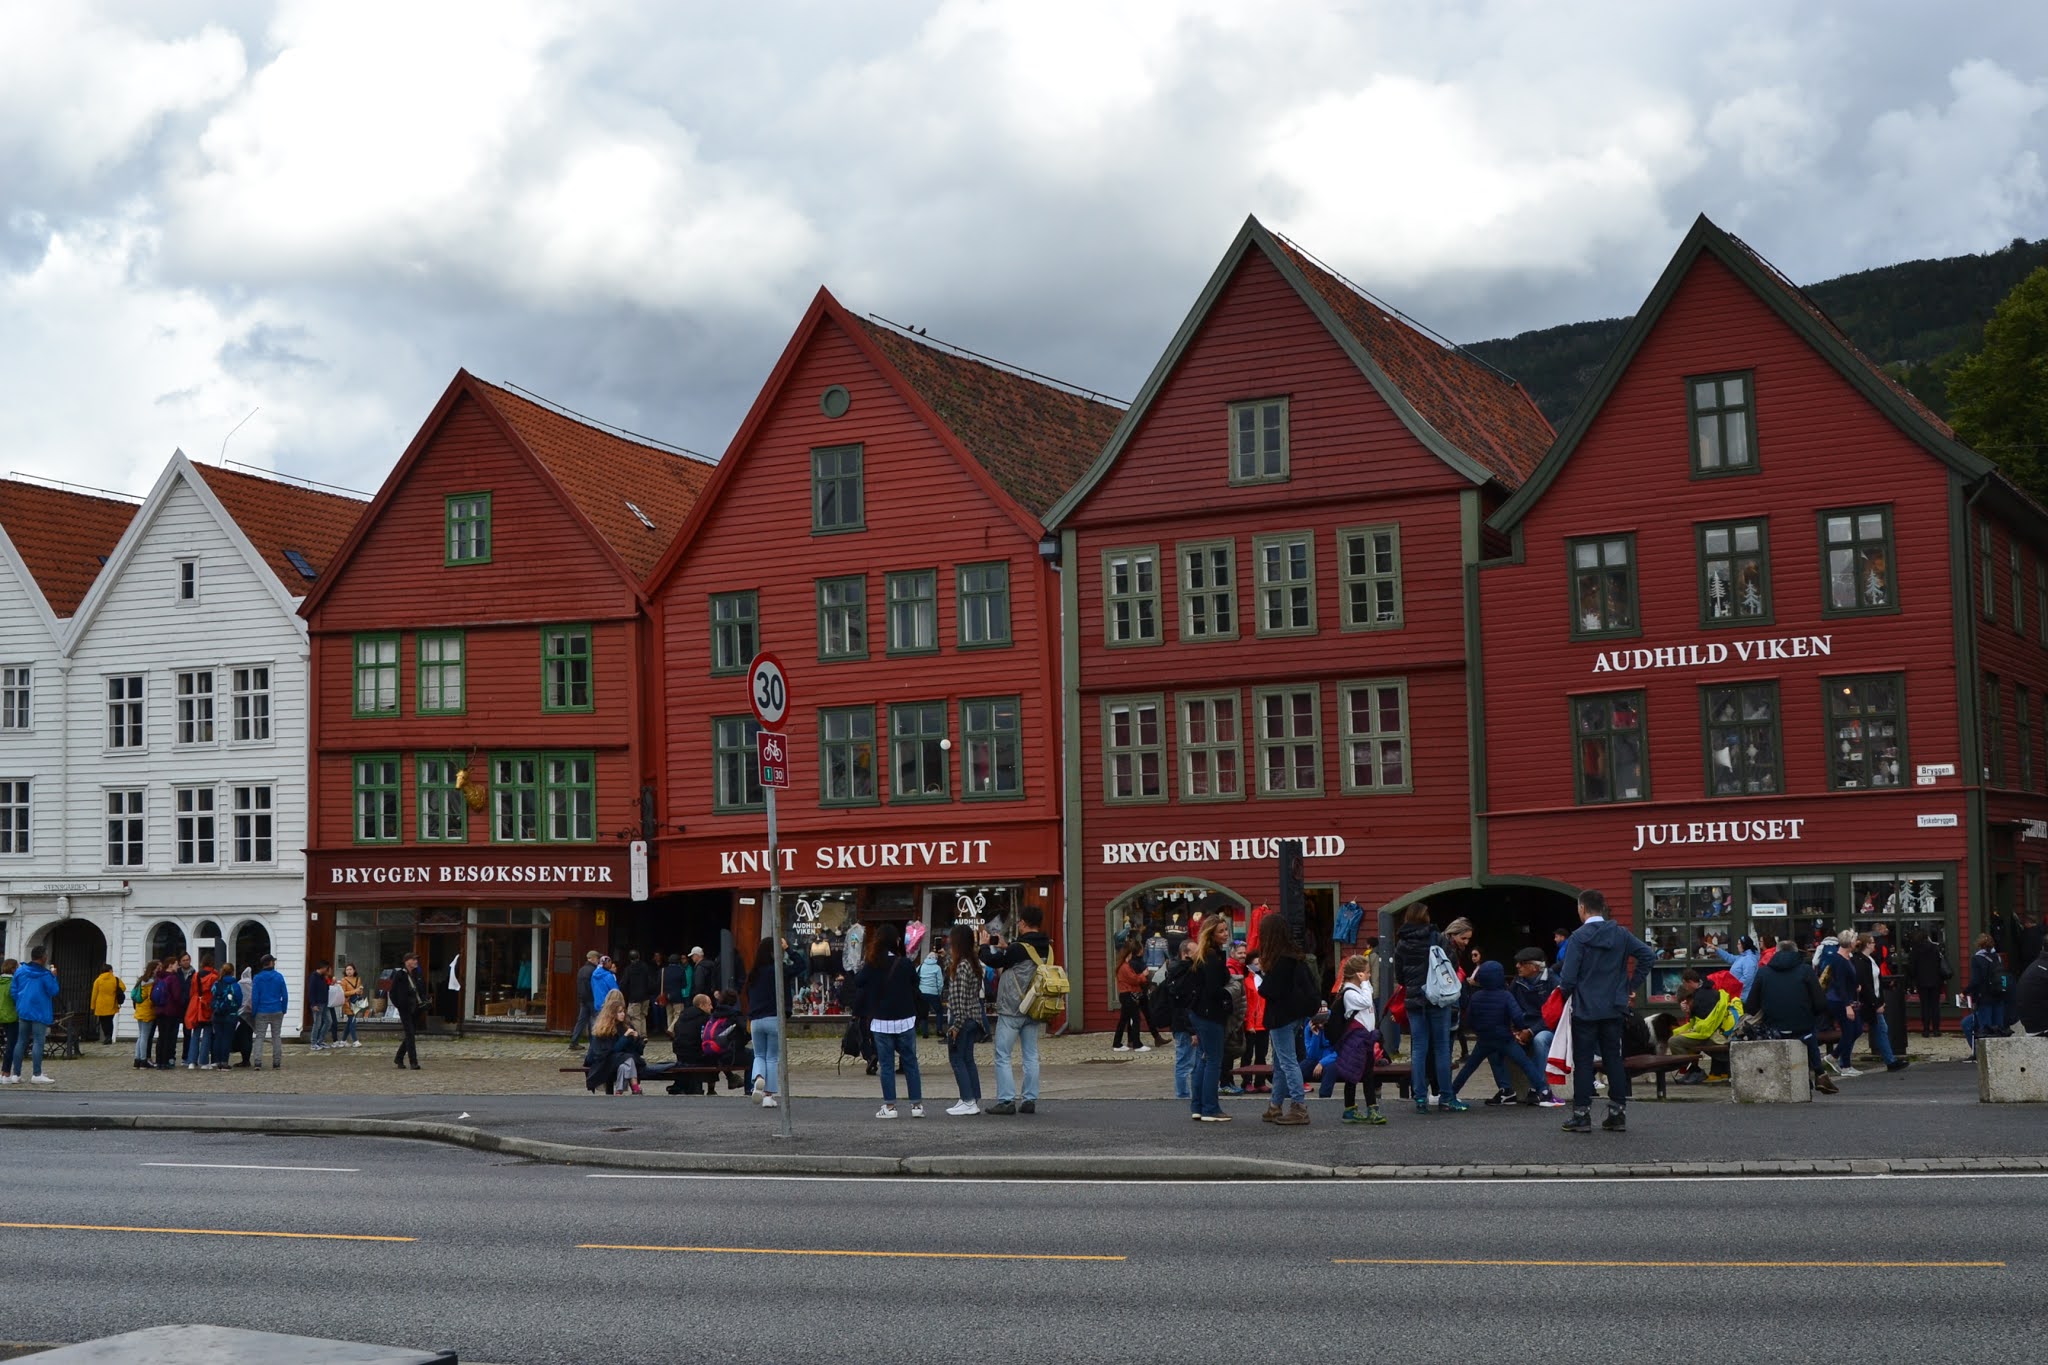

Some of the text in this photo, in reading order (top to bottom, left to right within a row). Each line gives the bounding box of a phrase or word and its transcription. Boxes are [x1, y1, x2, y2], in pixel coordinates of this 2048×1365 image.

[1592, 634, 1832, 673] AUDHILD VIKEN
[757, 671, 783, 710] 30
[775, 769, 783, 780] 30
[1921, 766, 1950, 776] Bryggen
[1632, 818, 1804, 852] JULEHUSET
[1920, 816, 1955, 826] Tyskebryggen
[720, 840, 992, 875] KNUT SKURTVEIT
[1102, 835, 1346, 864] BRYGGEN HUSLID
[331, 867, 431, 883] BRYGGEN
[439, 865, 613, 882] BESØKSSENTER
